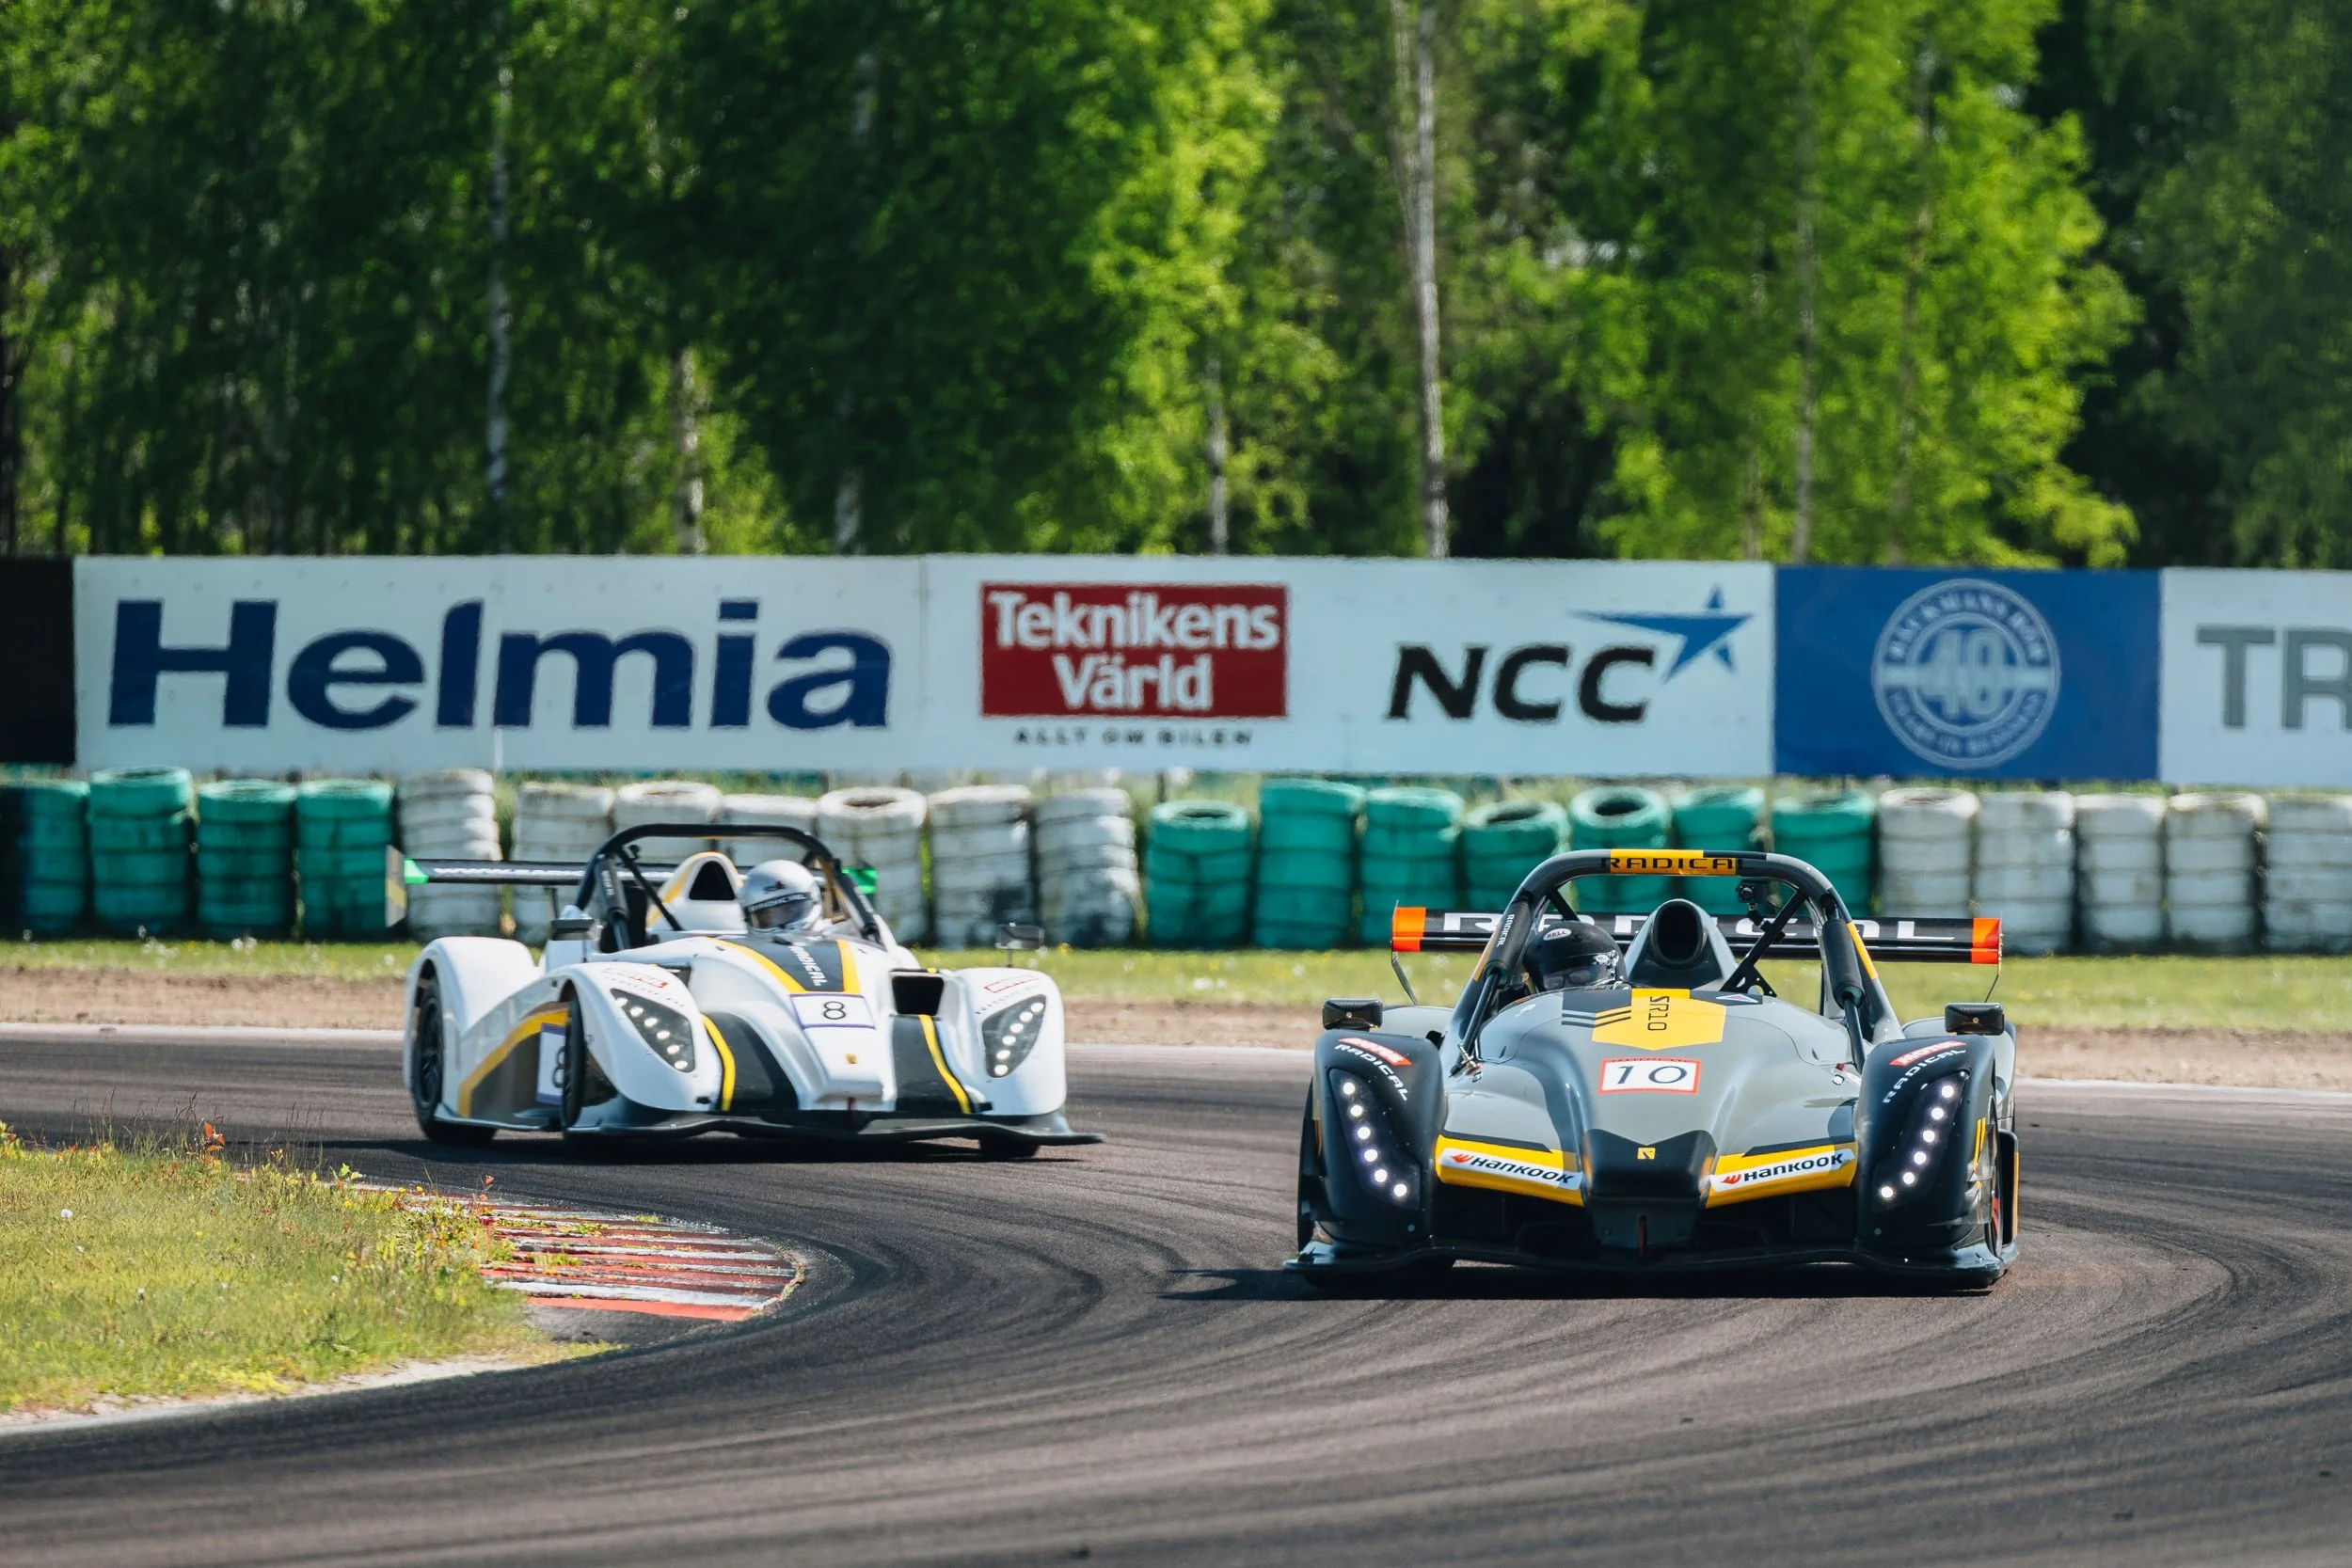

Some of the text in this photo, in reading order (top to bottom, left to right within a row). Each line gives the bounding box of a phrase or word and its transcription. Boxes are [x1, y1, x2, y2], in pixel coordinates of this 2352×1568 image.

[988, 591, 1280, 650] Teknikens
[108, 598, 893, 730] Helmia
[1051, 653, 1213, 709] Värld
[1385, 644, 1656, 723] NCC
[823, 1000, 847, 1021] 8
[1647, 995, 1670, 1031] SR10
[1334, 1043, 1409, 1101] RADICAL
[1617, 1065, 1688, 1085] 10
[1882, 1049, 1966, 1103] RADICAL
